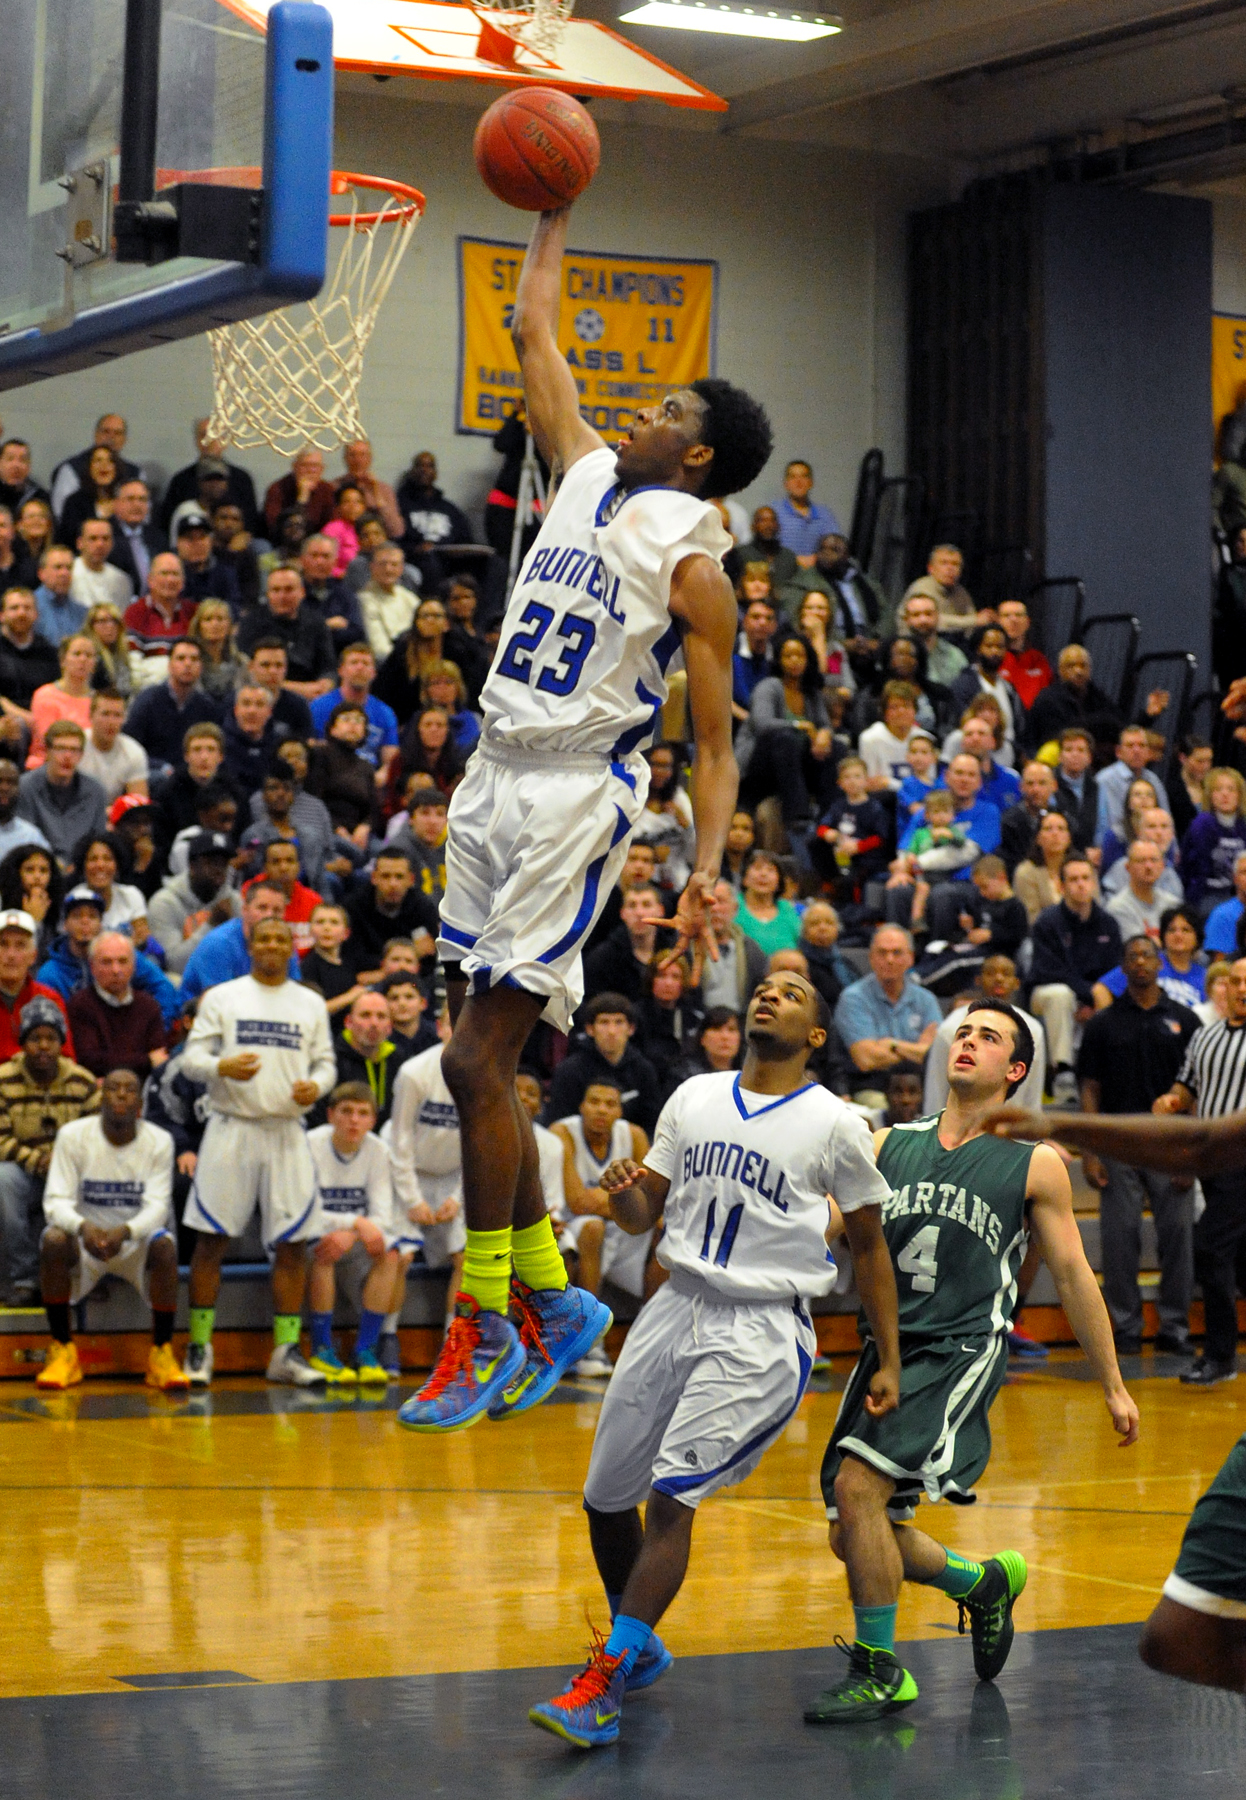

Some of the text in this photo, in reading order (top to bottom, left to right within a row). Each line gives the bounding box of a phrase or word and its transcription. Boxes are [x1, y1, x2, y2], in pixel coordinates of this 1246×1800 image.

[567, 267, 685, 306] CHAMPIONS
[638, 352, 655, 374] L
[647, 318, 675, 342] 11
[495, 599, 597, 697] 23
[683, 1141, 790, 1215] BUNNELL
[880, 1181, 1003, 1256] PARTANS
[897, 1224, 941, 1294] 4
